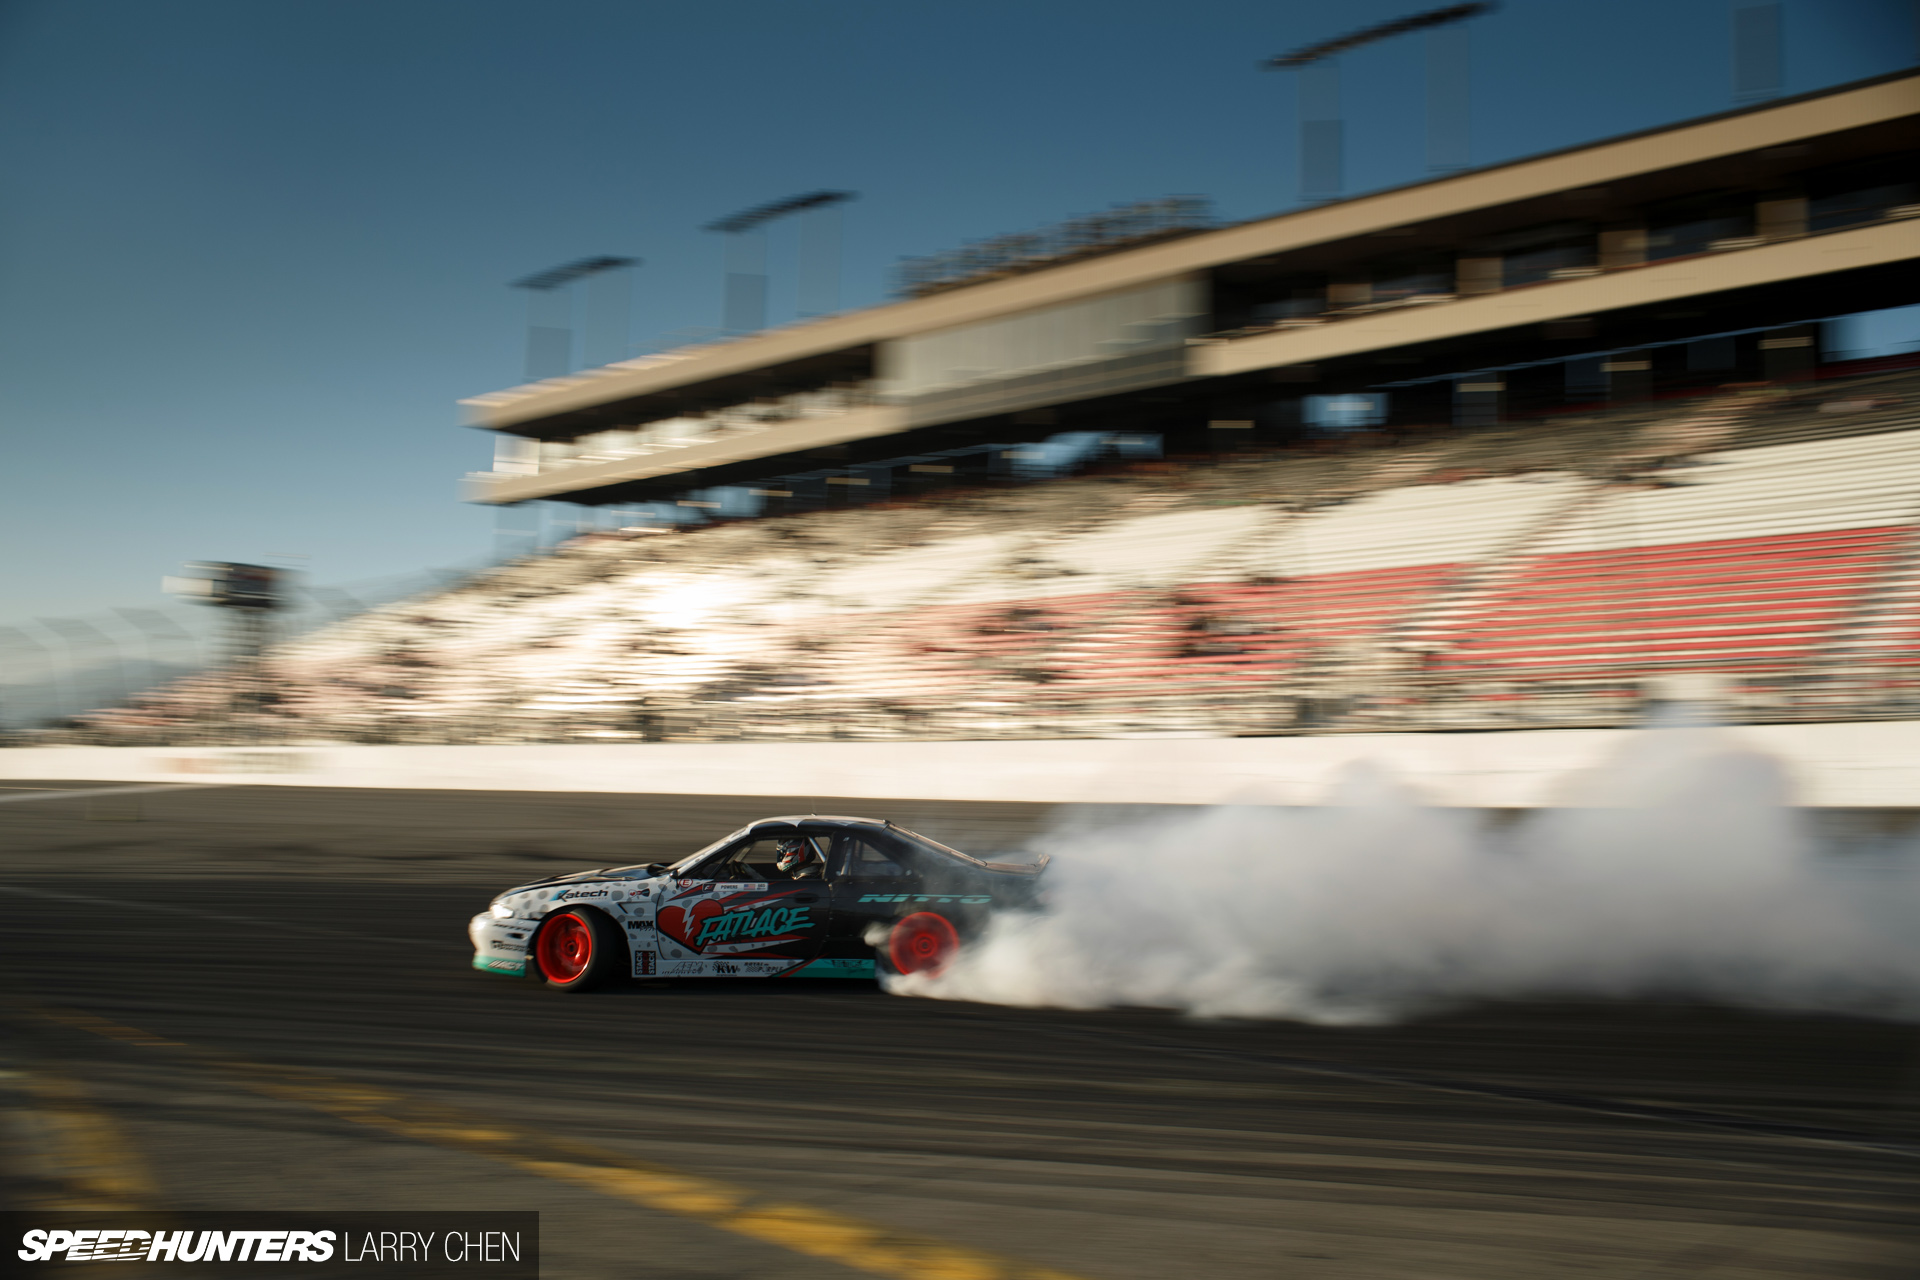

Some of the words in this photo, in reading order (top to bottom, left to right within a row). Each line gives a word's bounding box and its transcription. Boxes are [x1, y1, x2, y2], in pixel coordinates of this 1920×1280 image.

[556, 889, 609, 902] Katech
[857, 894, 992, 904] NITTO
[627, 920, 654, 930] MAX
[696, 907, 816, 946] FATLACE
[716, 964, 738, 974] KW
